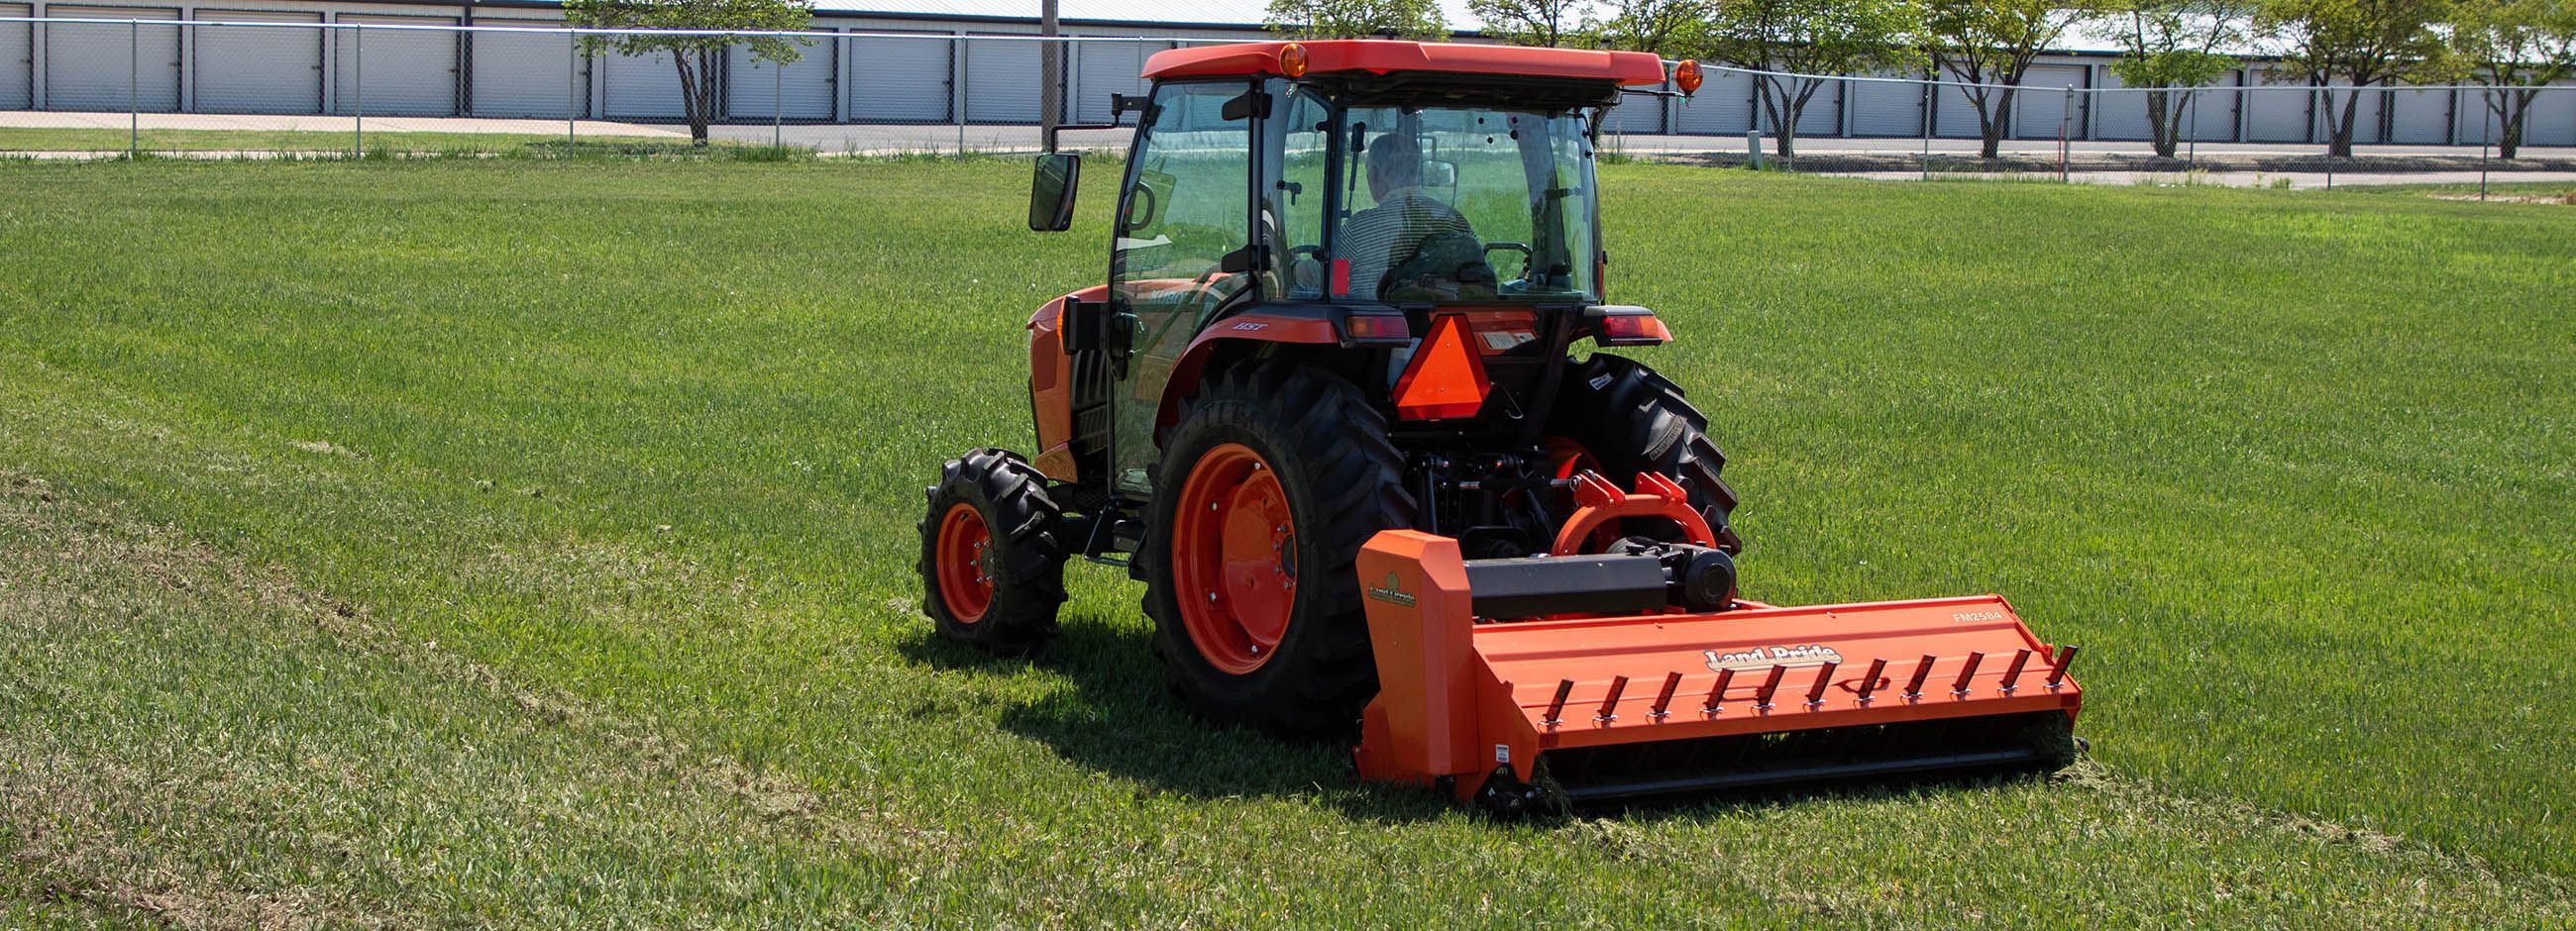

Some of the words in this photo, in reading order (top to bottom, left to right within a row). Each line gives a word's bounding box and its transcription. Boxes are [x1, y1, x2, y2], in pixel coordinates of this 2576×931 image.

[1232, 322, 1269, 331] HST
[1704, 647, 1767, 668] Land
[1770, 645, 1839, 663] Pride
